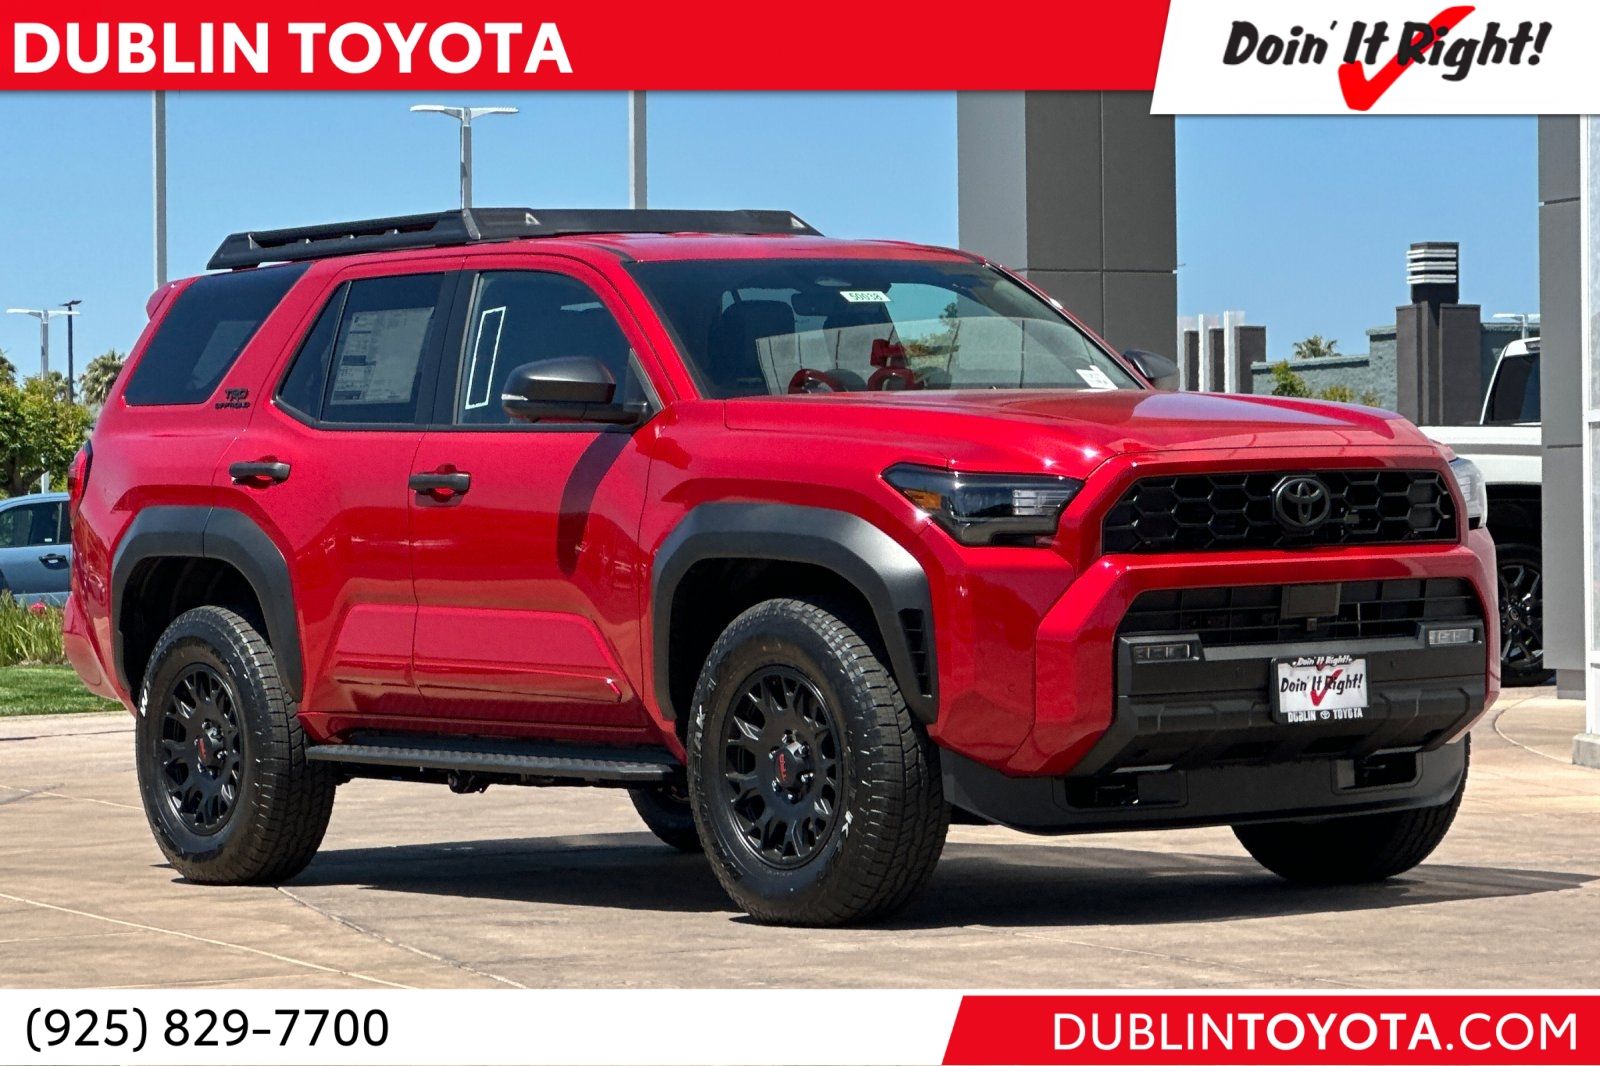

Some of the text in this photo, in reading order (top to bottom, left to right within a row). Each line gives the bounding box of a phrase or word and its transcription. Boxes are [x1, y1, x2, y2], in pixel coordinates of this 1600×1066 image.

[1280, 673, 1363, 695] Doin' It Right!
[1287, 707, 1363, 723] DUBLIN TOYOTA
